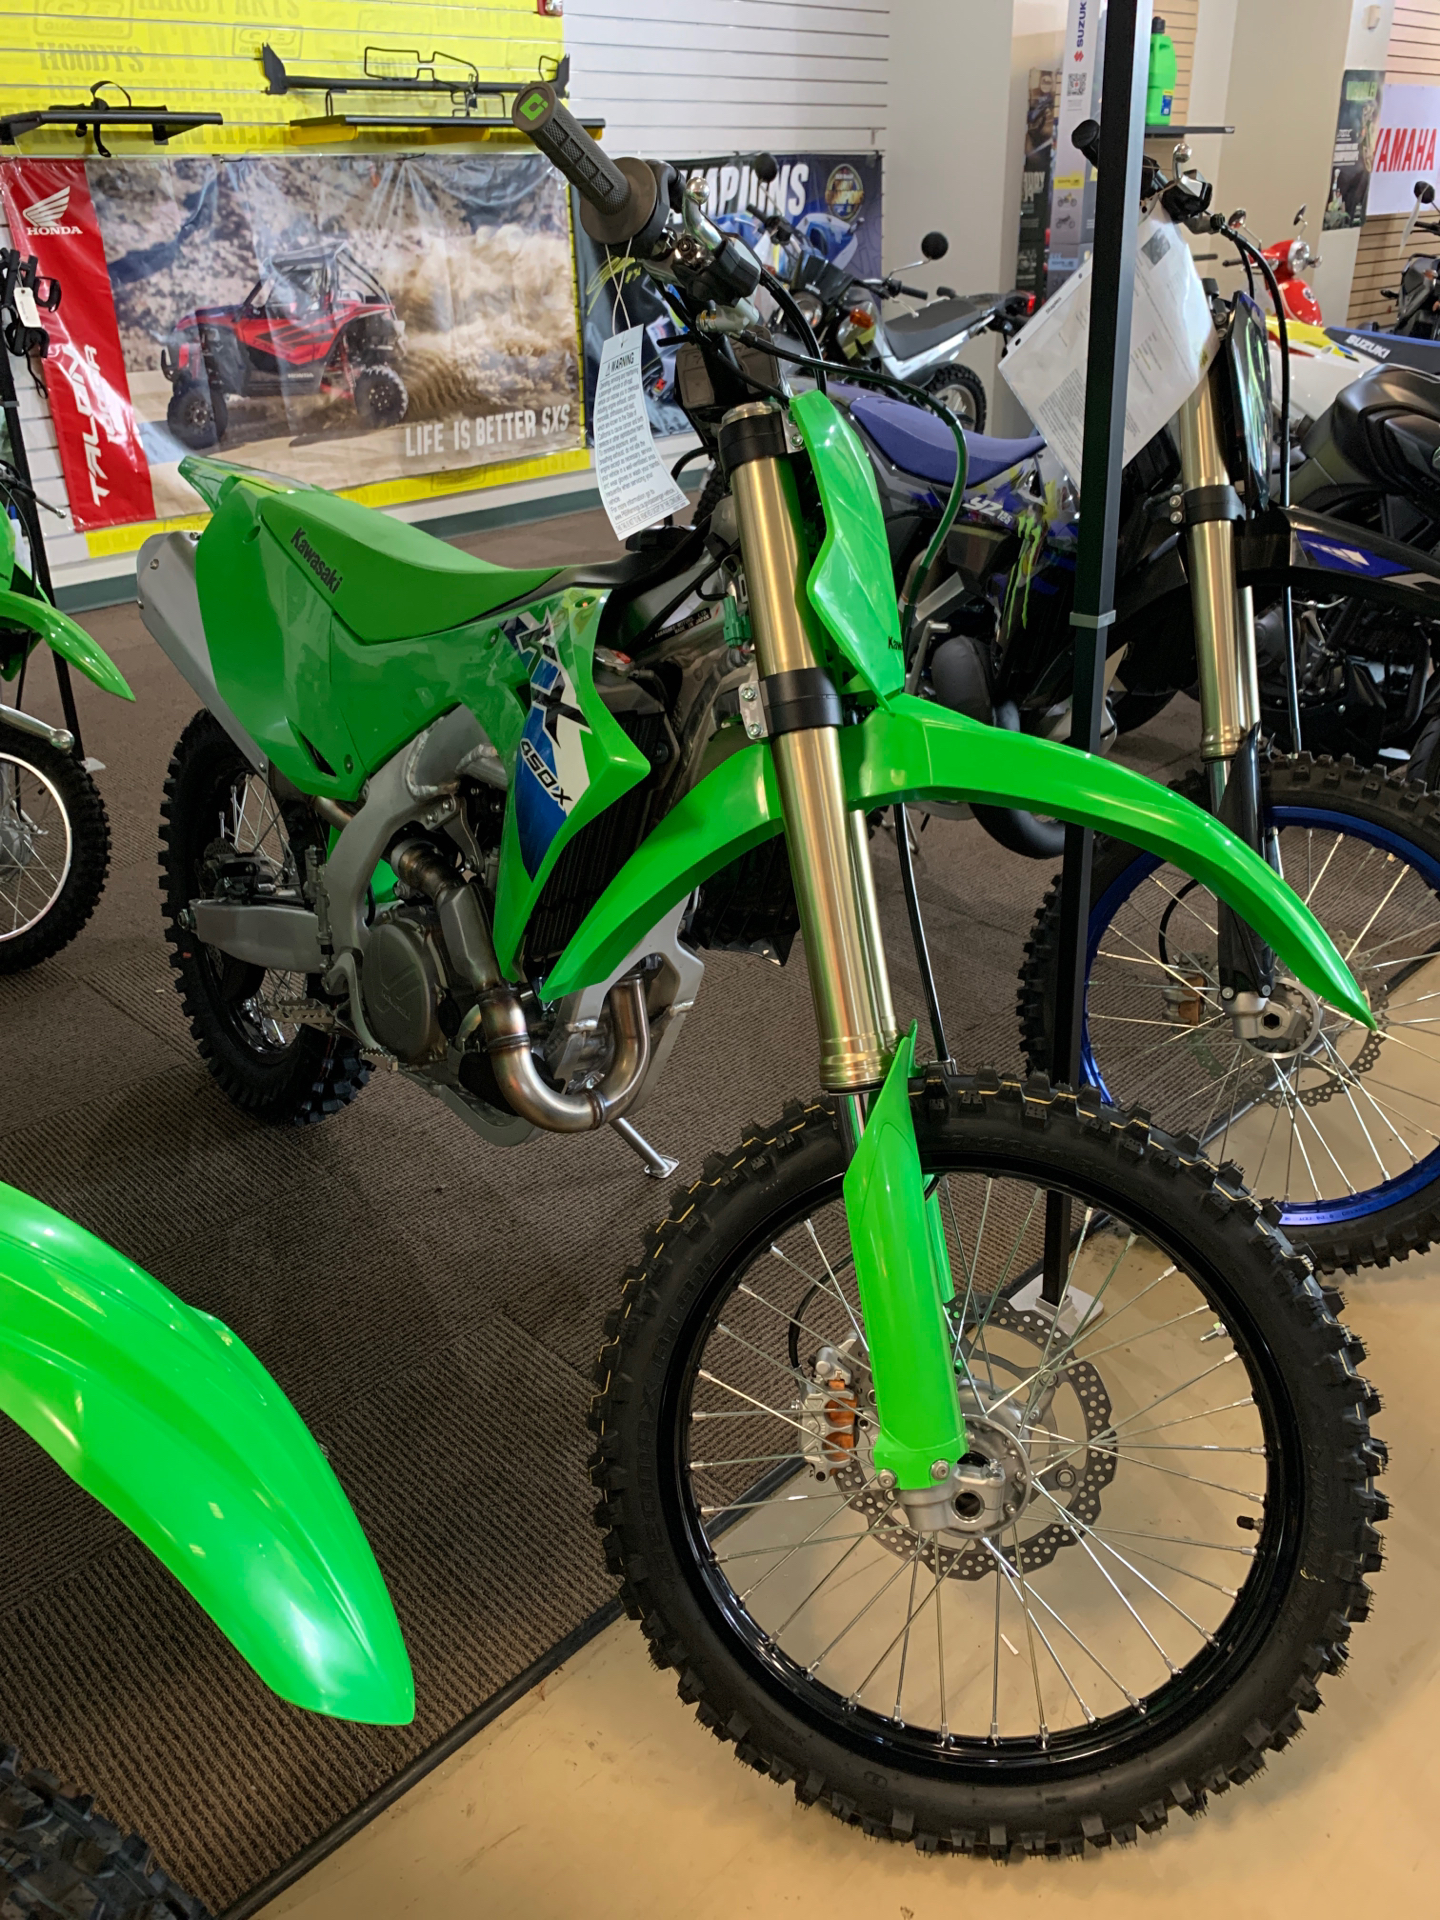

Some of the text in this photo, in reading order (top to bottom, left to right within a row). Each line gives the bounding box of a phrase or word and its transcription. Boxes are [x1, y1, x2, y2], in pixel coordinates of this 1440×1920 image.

[35, 42, 145, 73] HOODYS
[26, 225, 83, 236] HONDA
[611, 352, 634, 371] WARNING
[1345, 334, 1392, 360] SUZUKI
[63, 346, 111, 507] TALON
[405, 403, 571, 457] LIFE IS BETTER SXS
[996, 511, 1014, 526] 125
[290, 526, 343, 594] Kawasaki
[521, 738, 573, 805] 450X
